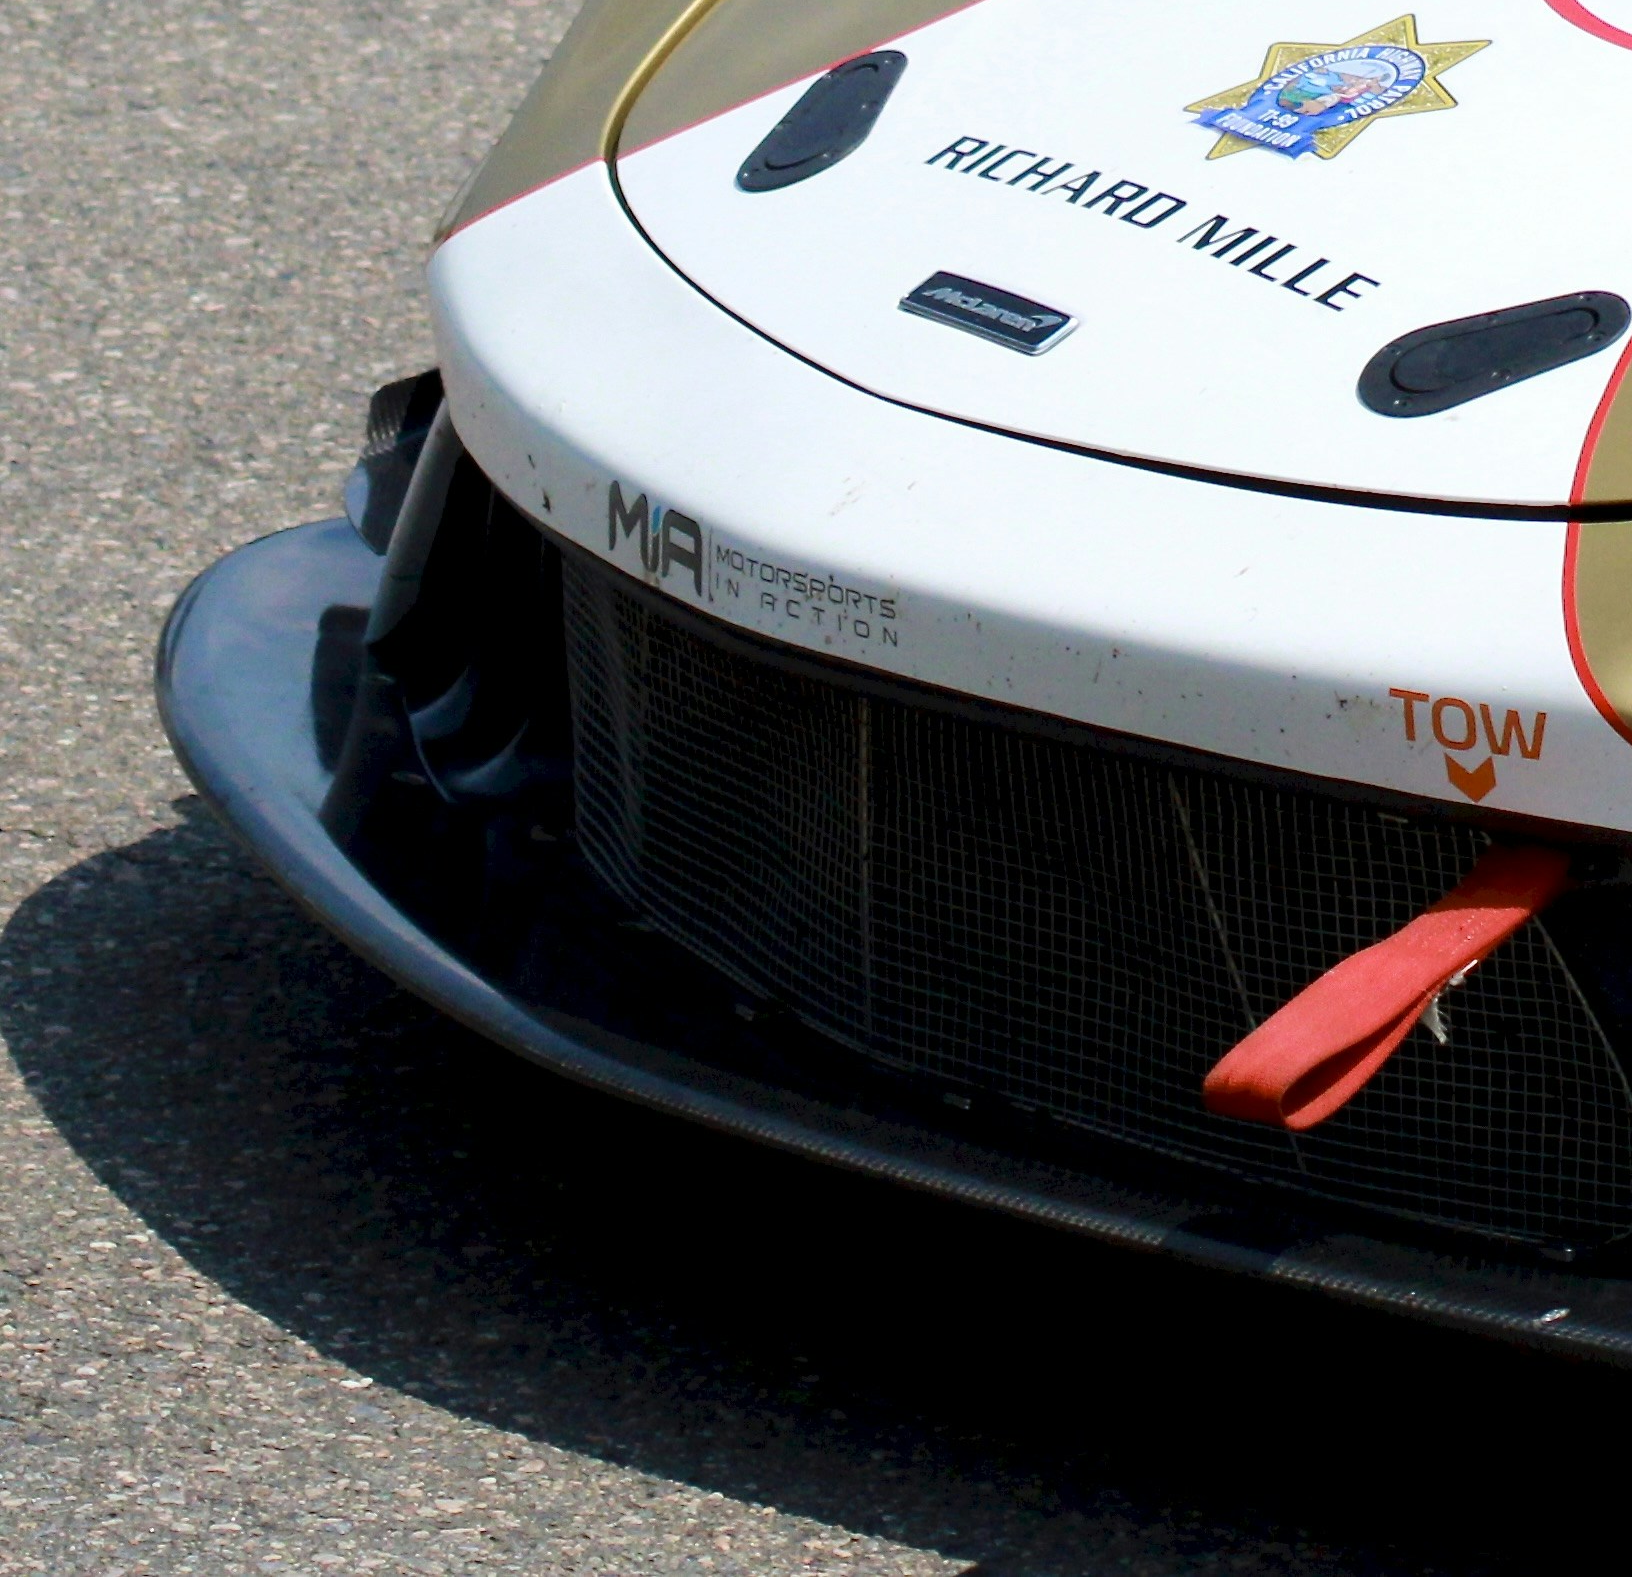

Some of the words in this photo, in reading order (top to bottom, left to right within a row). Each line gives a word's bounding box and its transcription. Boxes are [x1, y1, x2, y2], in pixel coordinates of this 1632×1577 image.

[1270, 46, 1371, 92] CALIFORNIA
[1347, 84, 1412, 120] PATROL
[1215, 111, 1301, 148] FOUNDATION
[925, 135, 1188, 230] RICHARD
[1178, 214, 1380, 313] MILLE
[715, 573, 740, 599] IN
[760, 592, 898, 648] ACTION
[716, 544, 897, 620] MOTORSPORTS
[1388, 687, 1547, 760] TOW
